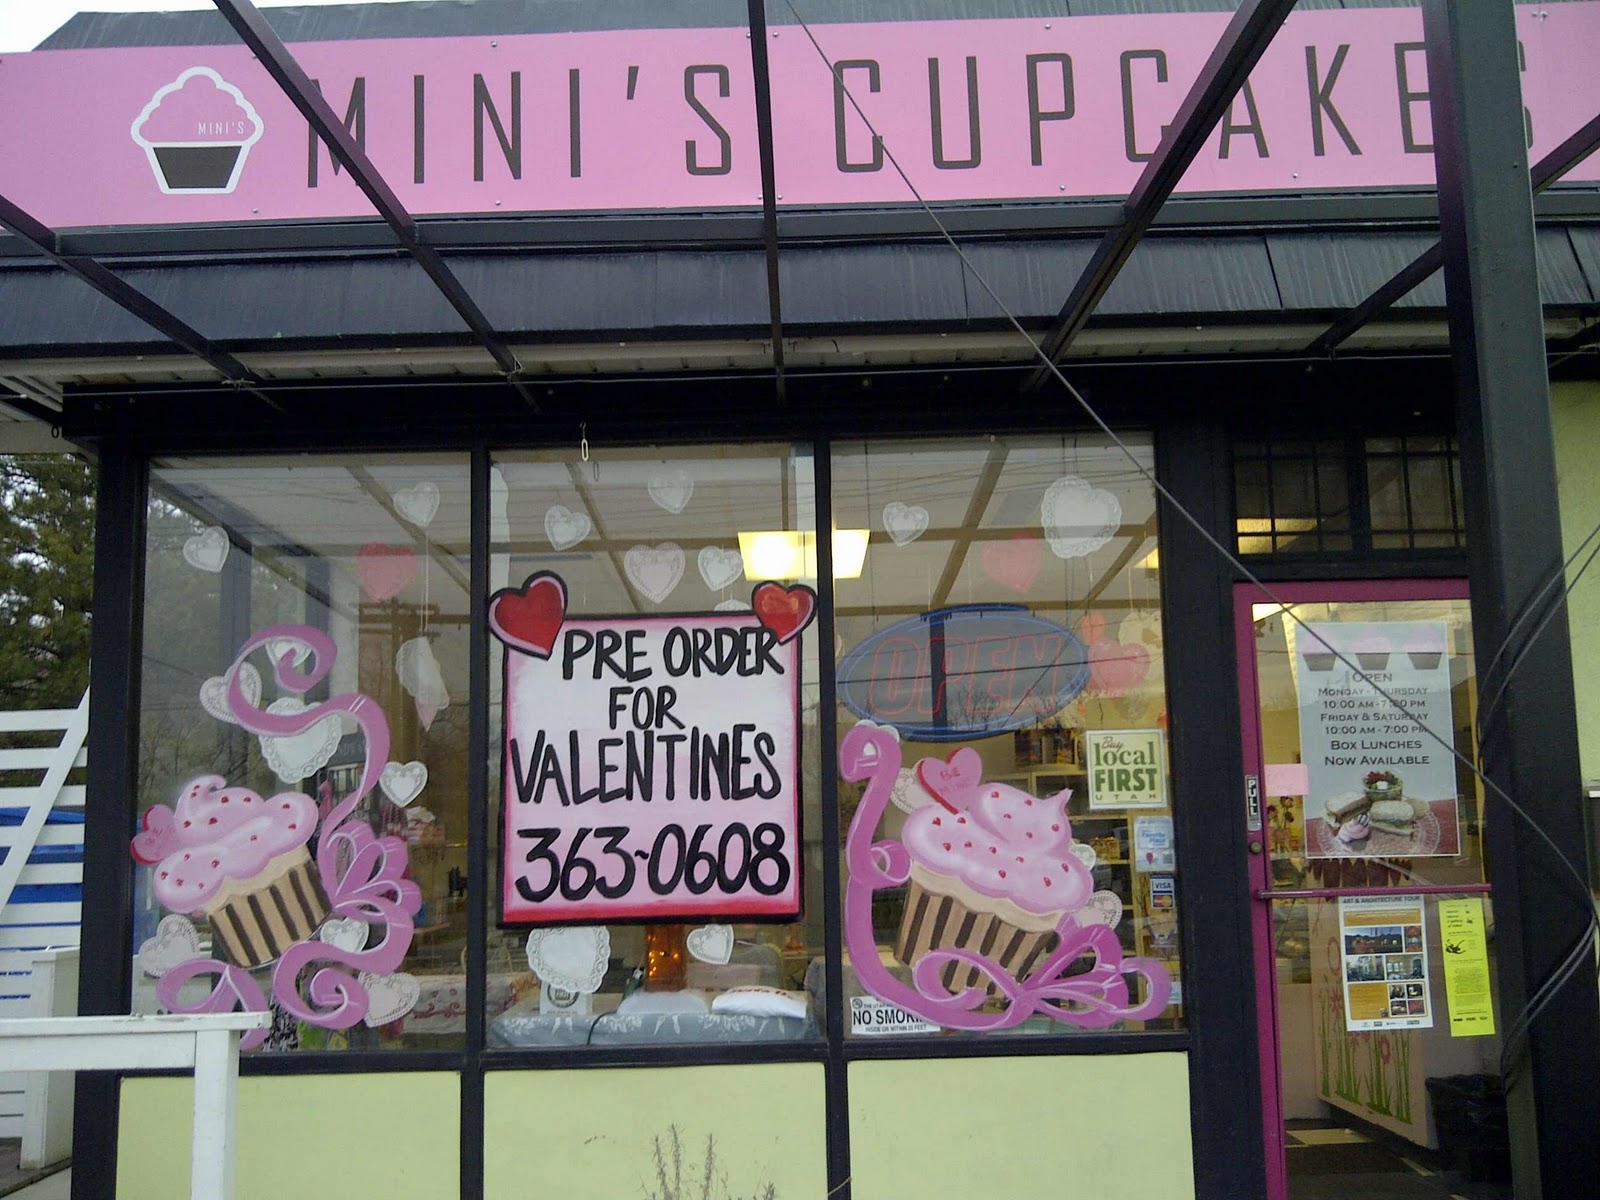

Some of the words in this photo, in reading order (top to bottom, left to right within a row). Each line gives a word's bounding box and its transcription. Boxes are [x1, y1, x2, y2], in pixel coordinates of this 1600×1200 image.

[307, 64, 732, 188] MINI'S
[832, 41, 1534, 173] CUPCAKE
[198, 121, 245, 135] MINI'S
[562, 629, 652, 681] PRE
[662, 626, 784, 677] ORDER
[867, 636, 1065, 716] OPEN
[1352, 673, 1393, 682] OPEN
[1318, 688, 1364, 697] MONDAY
[609, 686, 685, 730] FOR
[1324, 700, 1355, 709] 10:00
[1410, 700, 1425, 708] PM
[1320, 713, 1359, 722] FRIDAY
[1362, 712, 1370, 721] &
[1325, 726, 1357, 735] 10:00
[1360, 727, 1375, 735] AM
[1383, 725, 1409, 734] 7:00
[1101, 736, 1123, 754] Buy
[1361, 739, 1422, 749] LUNCHES
[1094, 741, 1157, 767] local
[1324, 756, 1356, 765] NOW
[1360, 755, 1430, 765] AVAILABLE
[510, 724, 782, 806] VALENTINES
[1094, 768, 1158, 792] FIRST
[1247, 779, 1258, 816] PULL
[515, 822, 790, 902] 363-0608
[853, 1010, 872, 1026] NO
